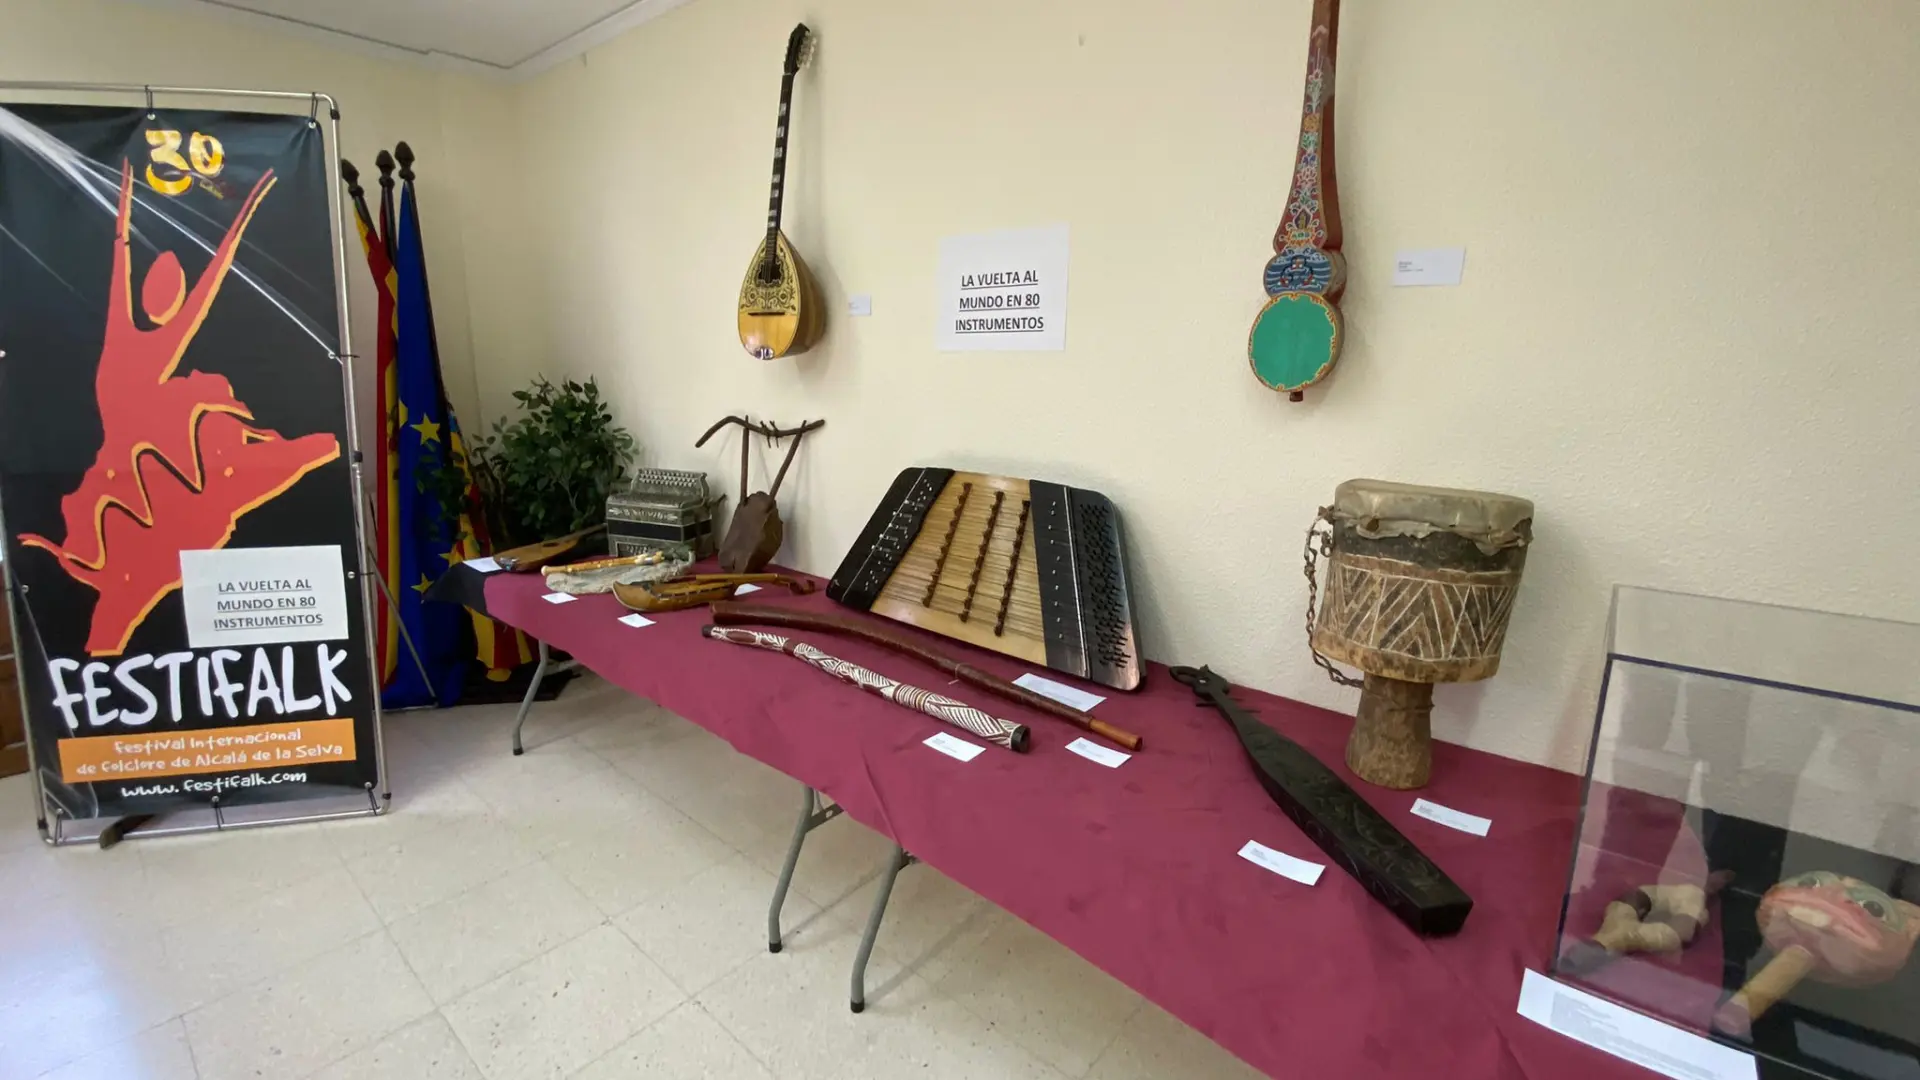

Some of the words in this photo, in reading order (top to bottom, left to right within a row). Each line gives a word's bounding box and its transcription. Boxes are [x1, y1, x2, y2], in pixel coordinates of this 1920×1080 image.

[145, 128, 226, 196] 30
[961, 275, 975, 287] LA
[977, 271, 1021, 286] VUELTA
[1023, 269, 1039, 283] AL
[959, 295, 1003, 309] MUNDO
[1006, 294, 1022, 307] EN
[1024, 293, 1040, 306] 80
[955, 316, 1044, 331] INSTRUMENTOS
[218, 582, 236, 593] LA
[238, 579, 292, 591] VUELTA
[294, 578, 312, 589] AL
[217, 598, 274, 611] MUNDO
[277, 597, 296, 608] EN
[299, 596, 317, 607] 80
[213, 613, 324, 629] INSTRUMENTOS
[48, 643, 353, 729] FESTIFALK
[190, 727, 302, 751] Internacional
[76, 763, 98, 775] de
[170, 755, 192, 768] de
[195, 750, 248, 767] Alcalá
[251, 749, 272, 761] de
[275, 747, 292, 760] la
[295, 743, 344, 758] Selva
